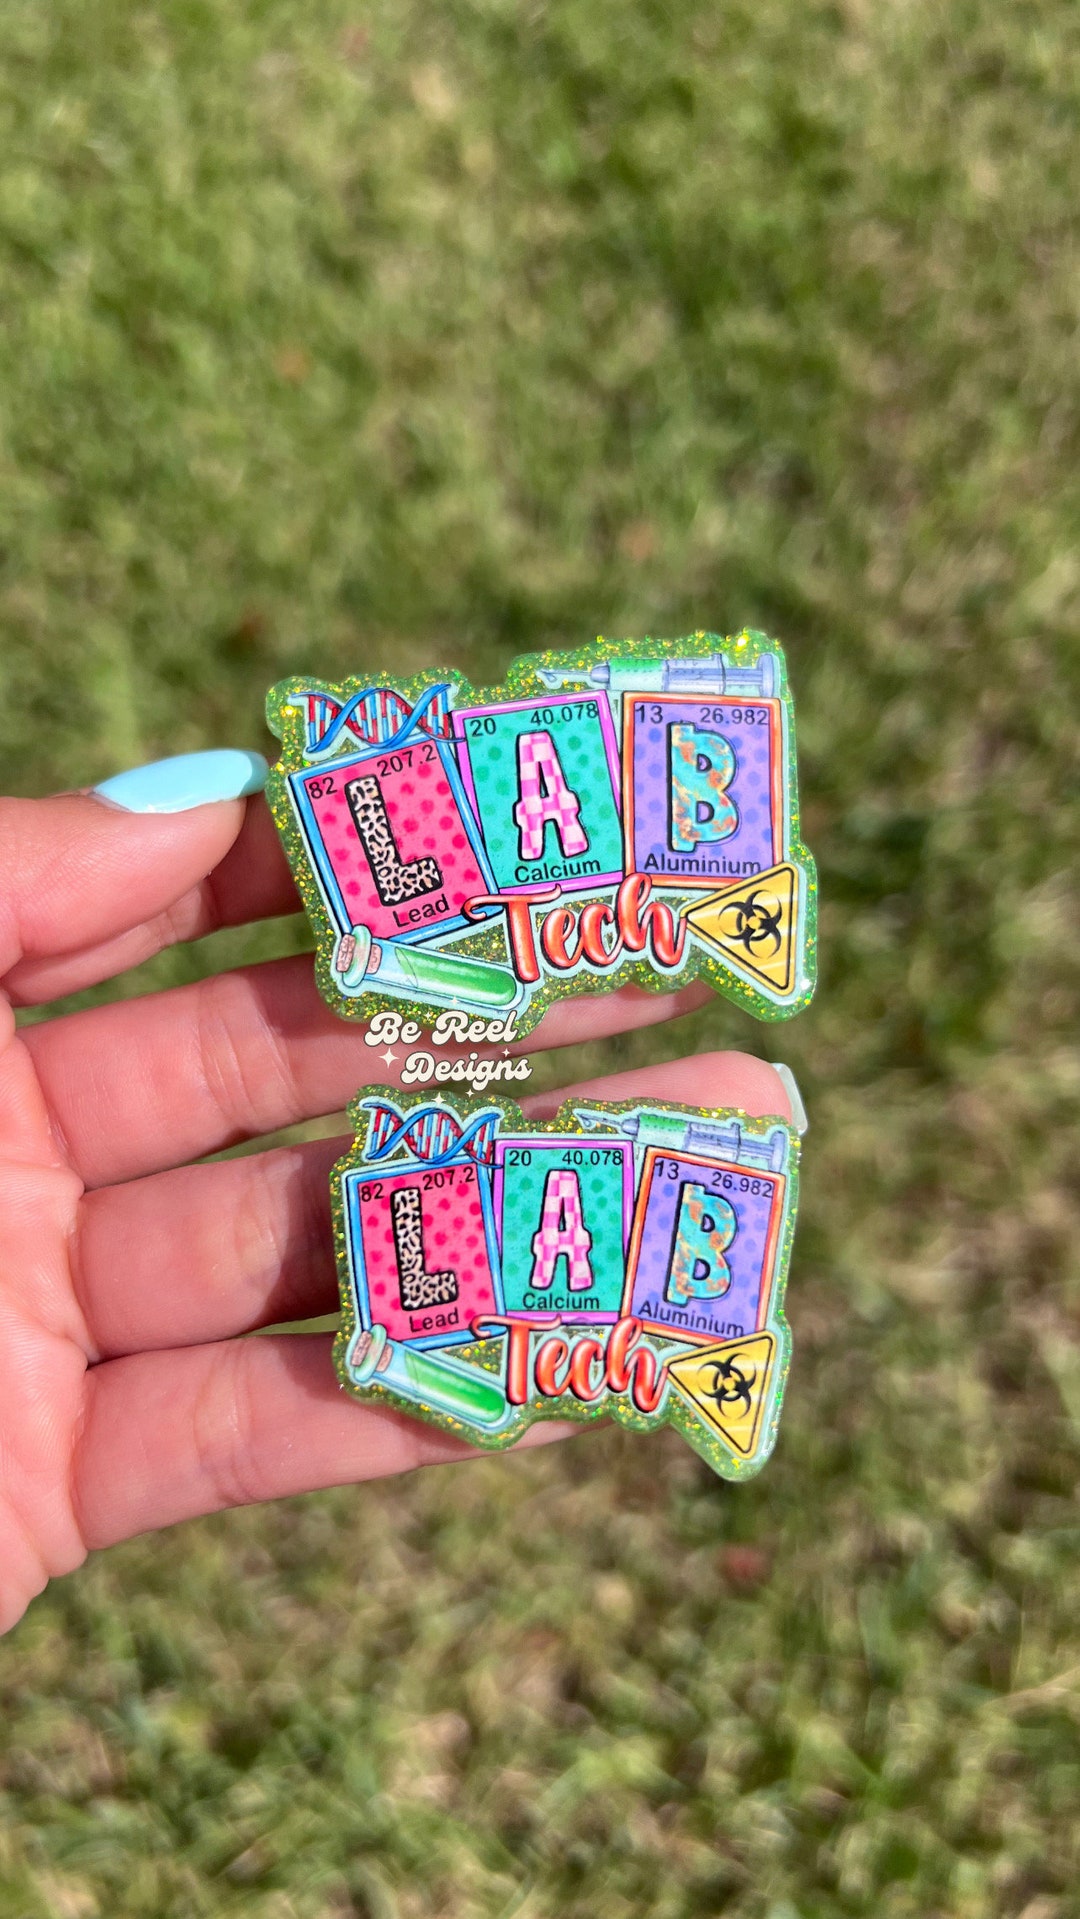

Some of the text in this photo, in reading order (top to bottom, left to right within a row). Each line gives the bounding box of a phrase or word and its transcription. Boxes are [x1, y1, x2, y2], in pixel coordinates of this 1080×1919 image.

[469, 703, 599, 737] 20 40.078
[634, 705, 770, 726] 13 26.982
[308, 744, 437, 800] 82 207.2
[514, 858, 601, 883] Calcium
[643, 853, 762, 874] Aluminium
[392, 893, 451, 928] Lead
[460, 872, 688, 984] Tech
[508, 1150, 624, 1167] 20 40.078
[360, 1166, 476, 1202] 82 207.2
[654, 1159, 773, 1198] 13 26.982
[522, 1292, 600, 1311] Calcium
[409, 1307, 460, 1333] Lead
[638, 1300, 744, 1338] Aluminium
[469, 1313, 669, 1414] Tech
